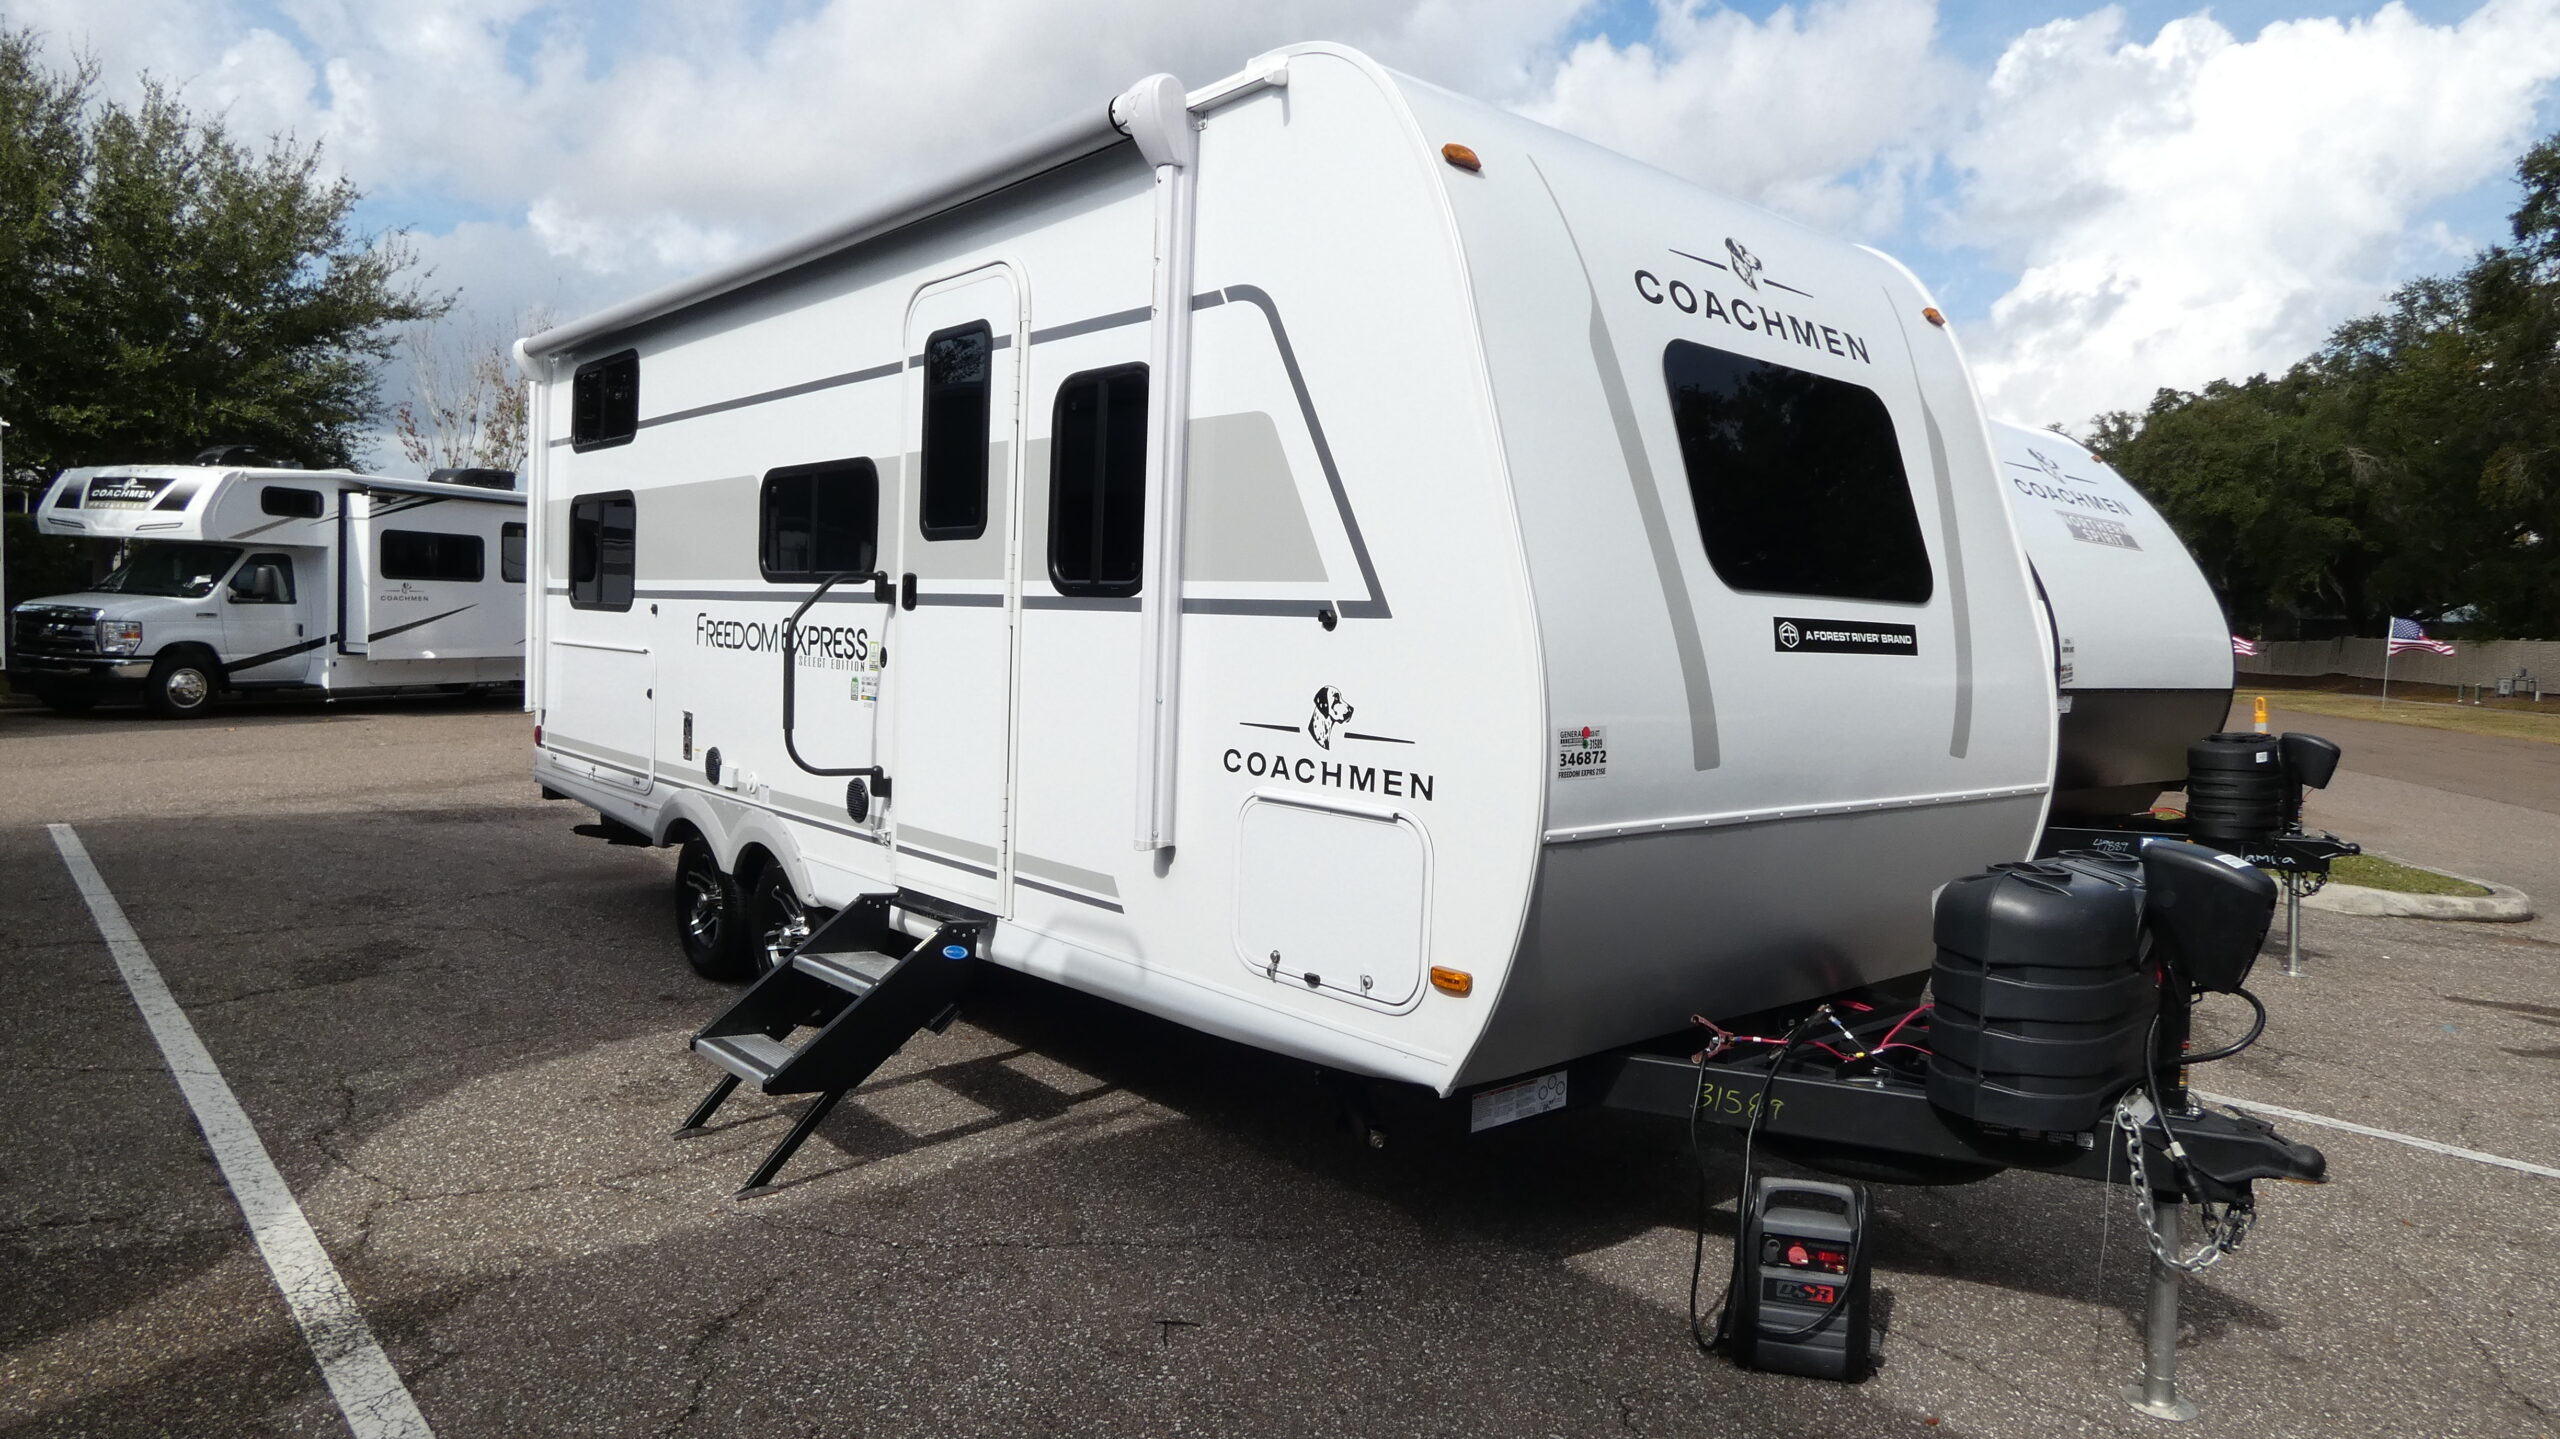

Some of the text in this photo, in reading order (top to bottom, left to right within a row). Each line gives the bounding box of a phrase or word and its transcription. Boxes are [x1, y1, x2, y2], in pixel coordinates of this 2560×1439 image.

[1634, 269, 1871, 365] COACHMEN
[91, 489, 156, 499] COACHMEN
[2013, 478, 2133, 516] COACHMEN
[1805, 630, 1813, 640] A
[1814, 631, 1850, 642] FOREST
[1880, 634, 1912, 645] BRAND
[798, 655, 865, 672] SELECT EDITION
[1560, 750, 1607, 767] 346872
[1223, 748, 1433, 801] COACHMEN
[1558, 770, 1580, 778] FREEDOM
